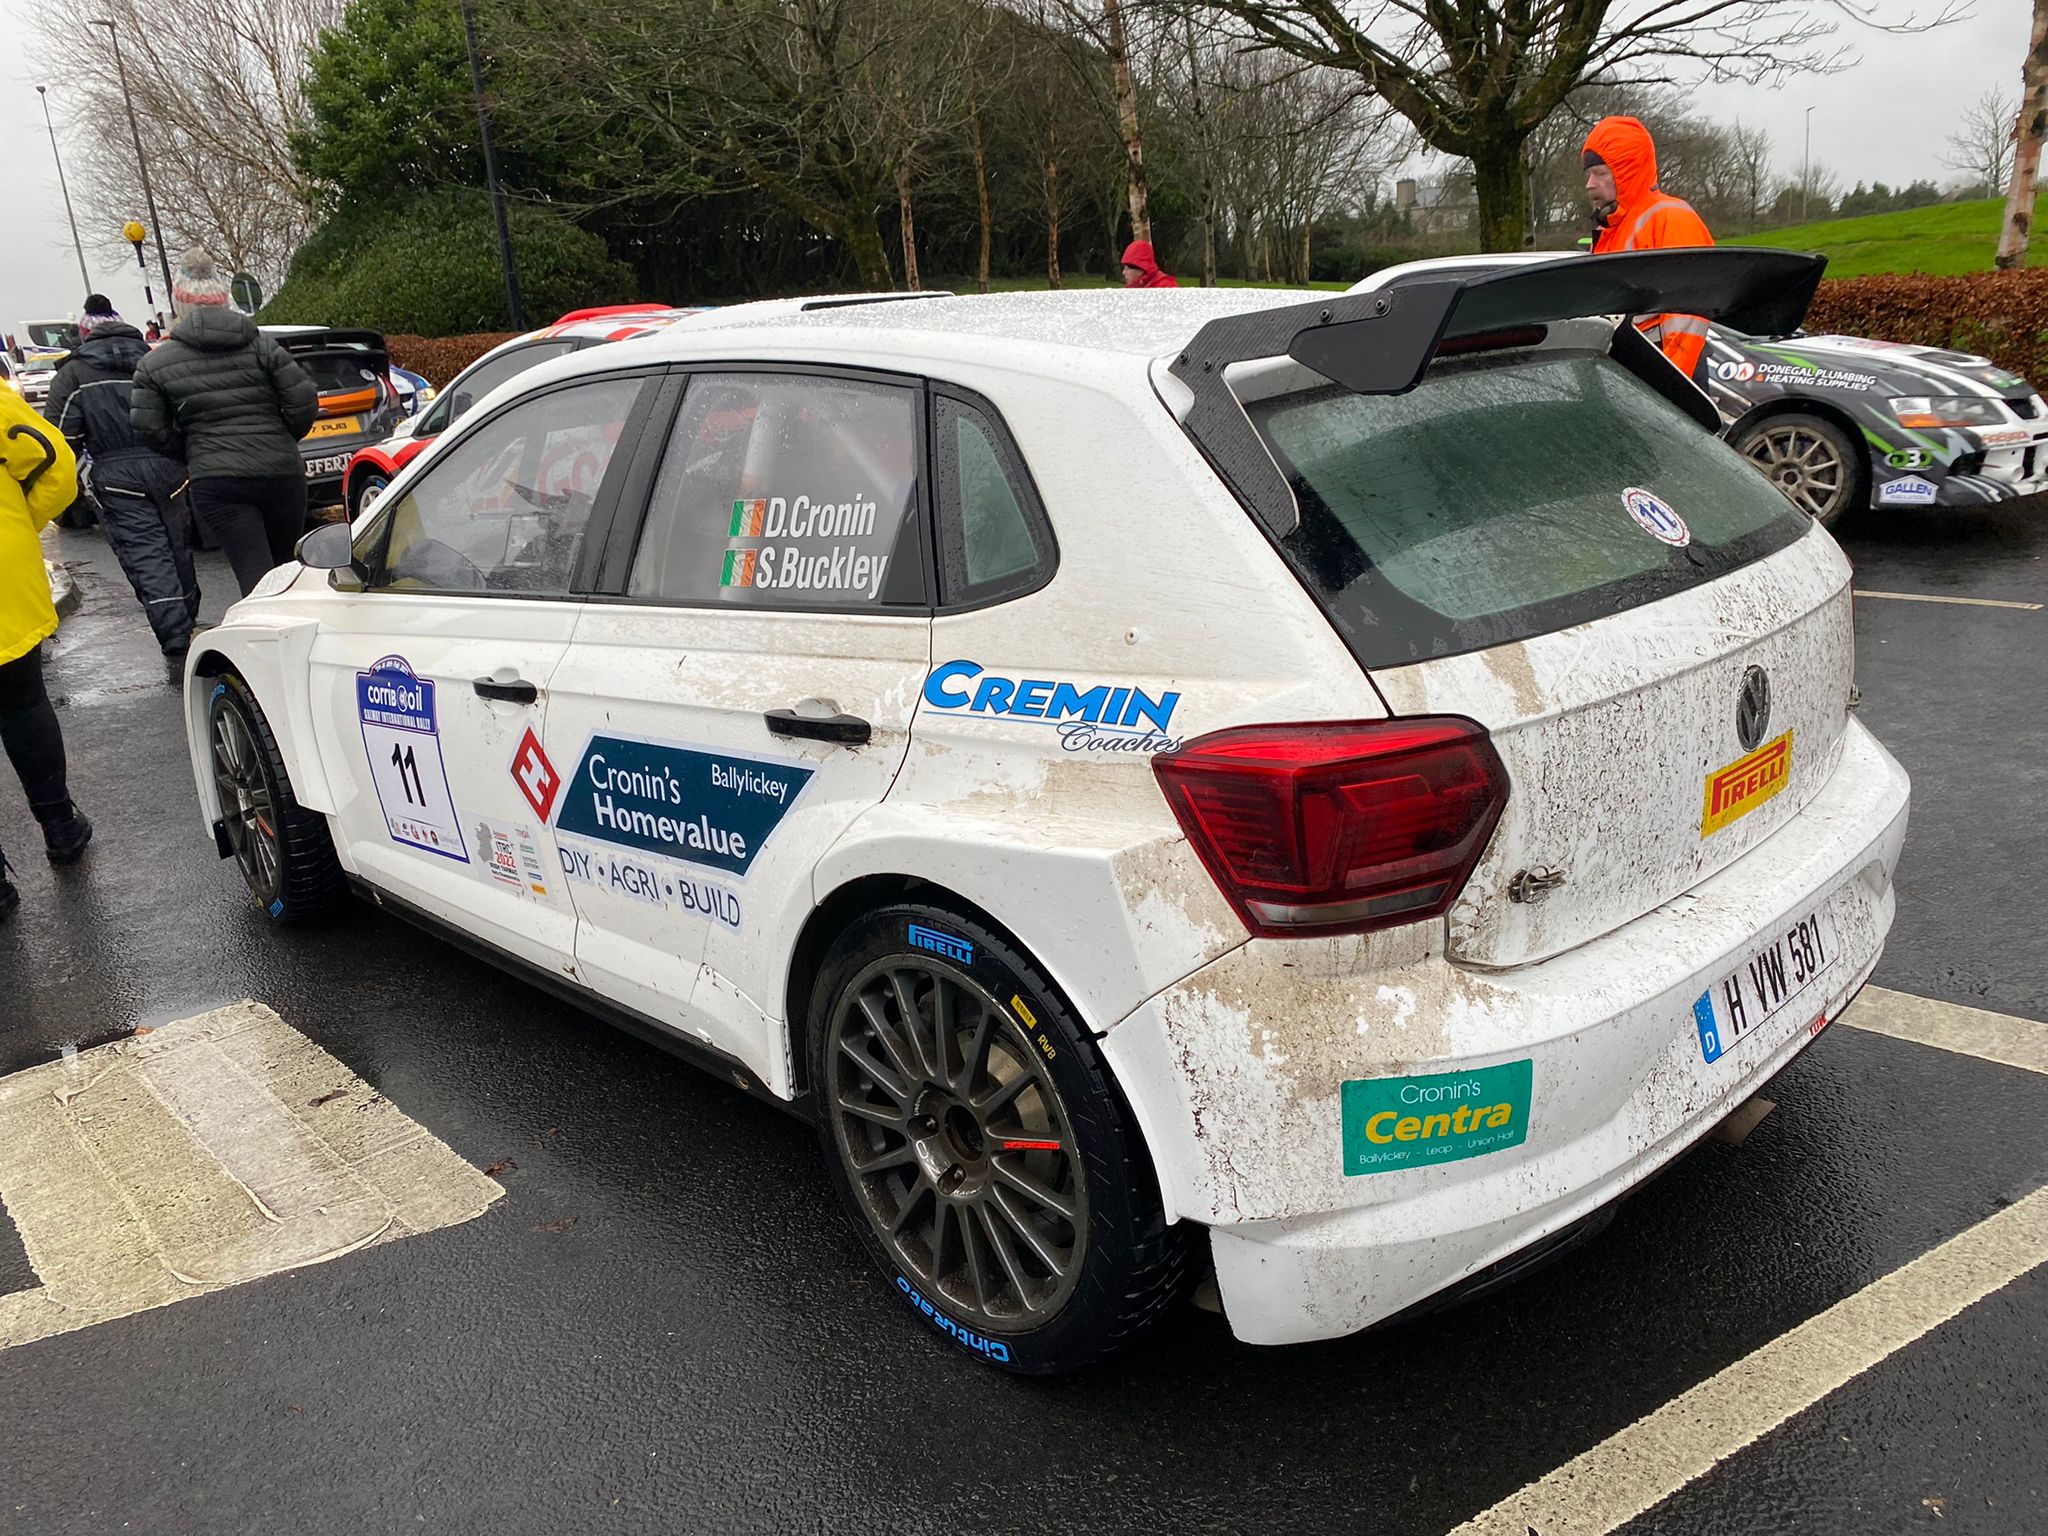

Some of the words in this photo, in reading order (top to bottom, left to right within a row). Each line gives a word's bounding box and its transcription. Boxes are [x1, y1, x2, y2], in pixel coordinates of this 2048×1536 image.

[1758, 363, 1815, 377] DONEGAL
[1815, 368, 1876, 385] PLUMBING
[1765, 374, 1815, 386] HEATING
[1815, 378, 1869, 391] SUPPLIES
[1886, 482, 1933, 496] GALLEN
[765, 493, 877, 538] D.Cronin
[1639, 501, 1676, 531] 11
[756, 546, 888, 600] S.Buckley
[408, 685, 422, 711] oil
[923, 659, 1181, 734] CREMIN
[1056, 720, 1184, 752] Coaches
[391, 743, 426, 807] 11
[588, 754, 681, 805] Cronin's
[711, 763, 788, 805] Ballylickey
[1711, 740, 1787, 817] PIRELLI
[592, 792, 747, 859] Homevalue
[495, 852, 516, 868] 2022
[559, 847, 590, 880] DIY
[611, 862, 659, 901] AGRI
[678, 879, 741, 928] BUILD
[908, 923, 974, 965] PIRELLI
[1704, 1030, 1716, 1054] D
[1724, 974, 1748, 1036] H
[1749, 941, 1787, 1013] VW
[1787, 913, 1825, 983] 581
[1037, 1033, 1057, 1060] RWB
[1400, 1079, 1481, 1104] Cronin's
[1365, 1103, 1512, 1144] Centra
[1359, 1150, 1411, 1165] Ballylickey
[1426, 1144, 1453, 1156] Leap
[1467, 1135, 1495, 1149] Union
[1497, 1130, 1514, 1142] Hall
